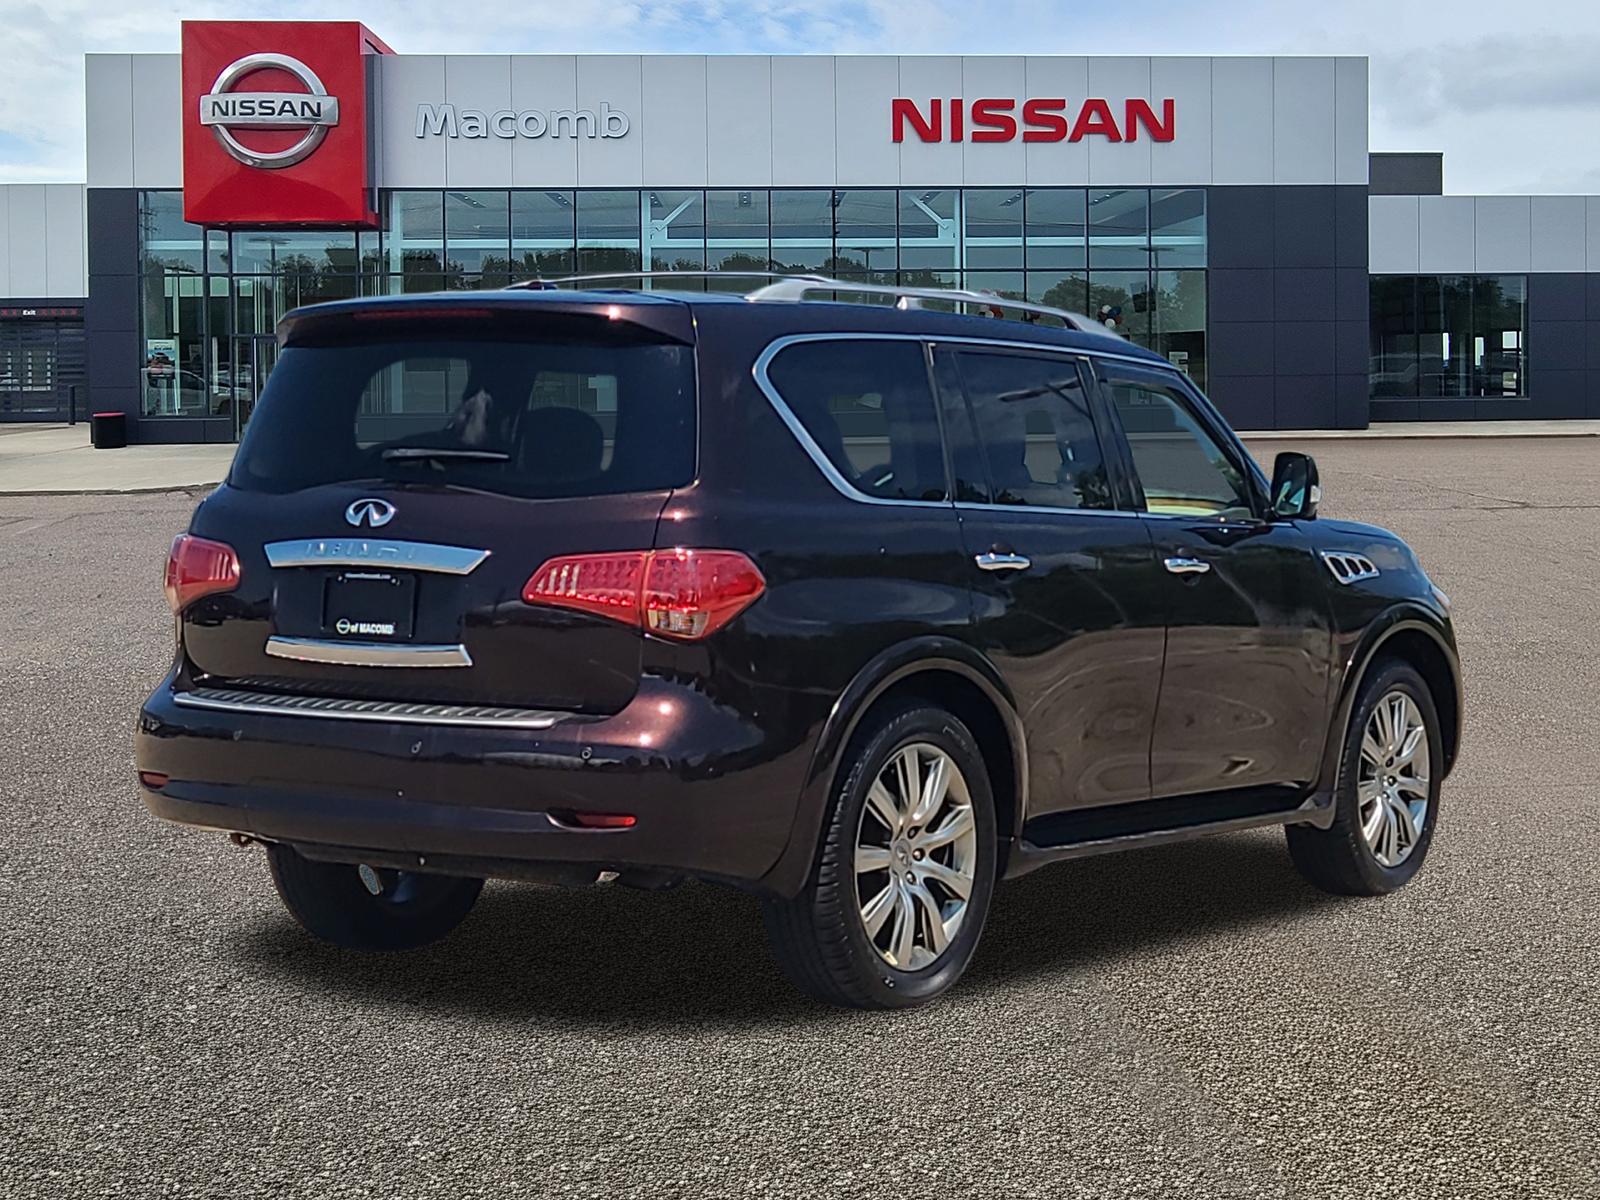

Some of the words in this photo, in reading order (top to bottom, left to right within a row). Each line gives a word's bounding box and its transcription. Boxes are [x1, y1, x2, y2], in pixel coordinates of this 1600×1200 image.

[211, 99, 322, 118] NISSAN
[415, 102, 630, 139] Macomb
[892, 98, 1175, 143] NISSAN
[359, 623, 394, 635] MACOMB
